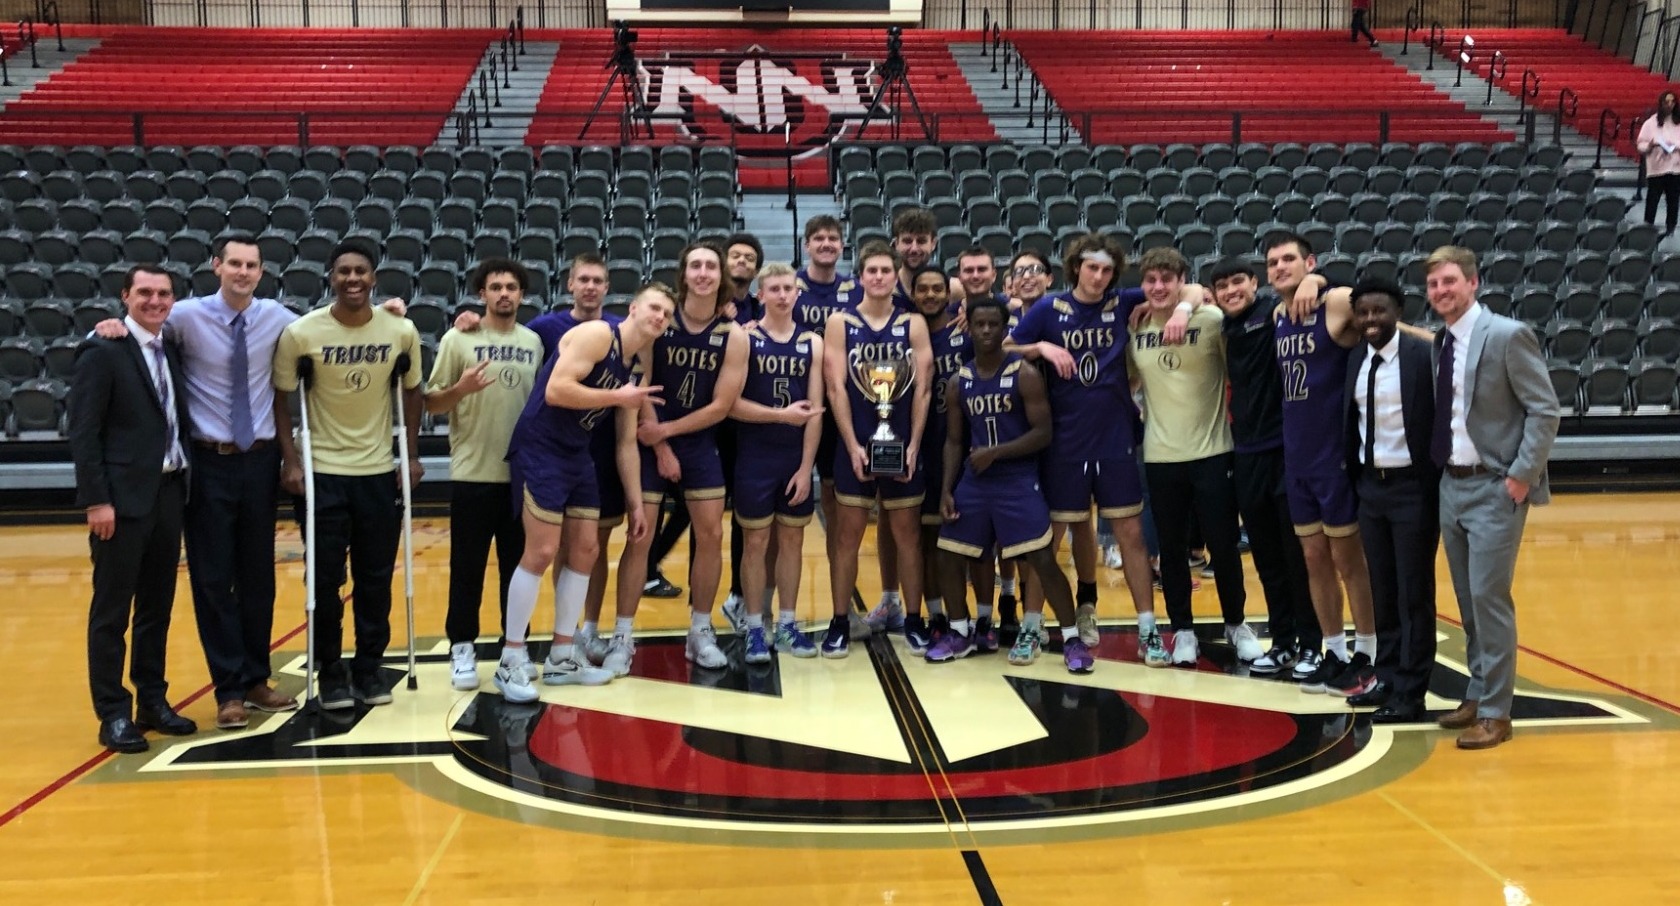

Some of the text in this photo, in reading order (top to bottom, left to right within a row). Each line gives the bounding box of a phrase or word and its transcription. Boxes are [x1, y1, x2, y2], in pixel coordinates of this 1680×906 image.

[801, 304, 847, 324] YOT
[1061, 327, 1113, 350] YOTES
[1136, 327, 1201, 350] TRT
[1276, 332, 1315, 359] YOTES
[322, 344, 392, 365] TRUST
[474, 345, 534, 364] TRUST
[666, 346, 718, 371] YOTES
[855, 342, 904, 361] YOTES
[757, 355, 806, 376] YOTES
[1079, 351, 1098, 386] 0
[676, 371, 696, 408] 4
[1282, 359, 1309, 402] 12
[773, 377, 791, 408] 5
[966, 393, 1013, 416] YOTES
[984, 416, 998, 448] 1
